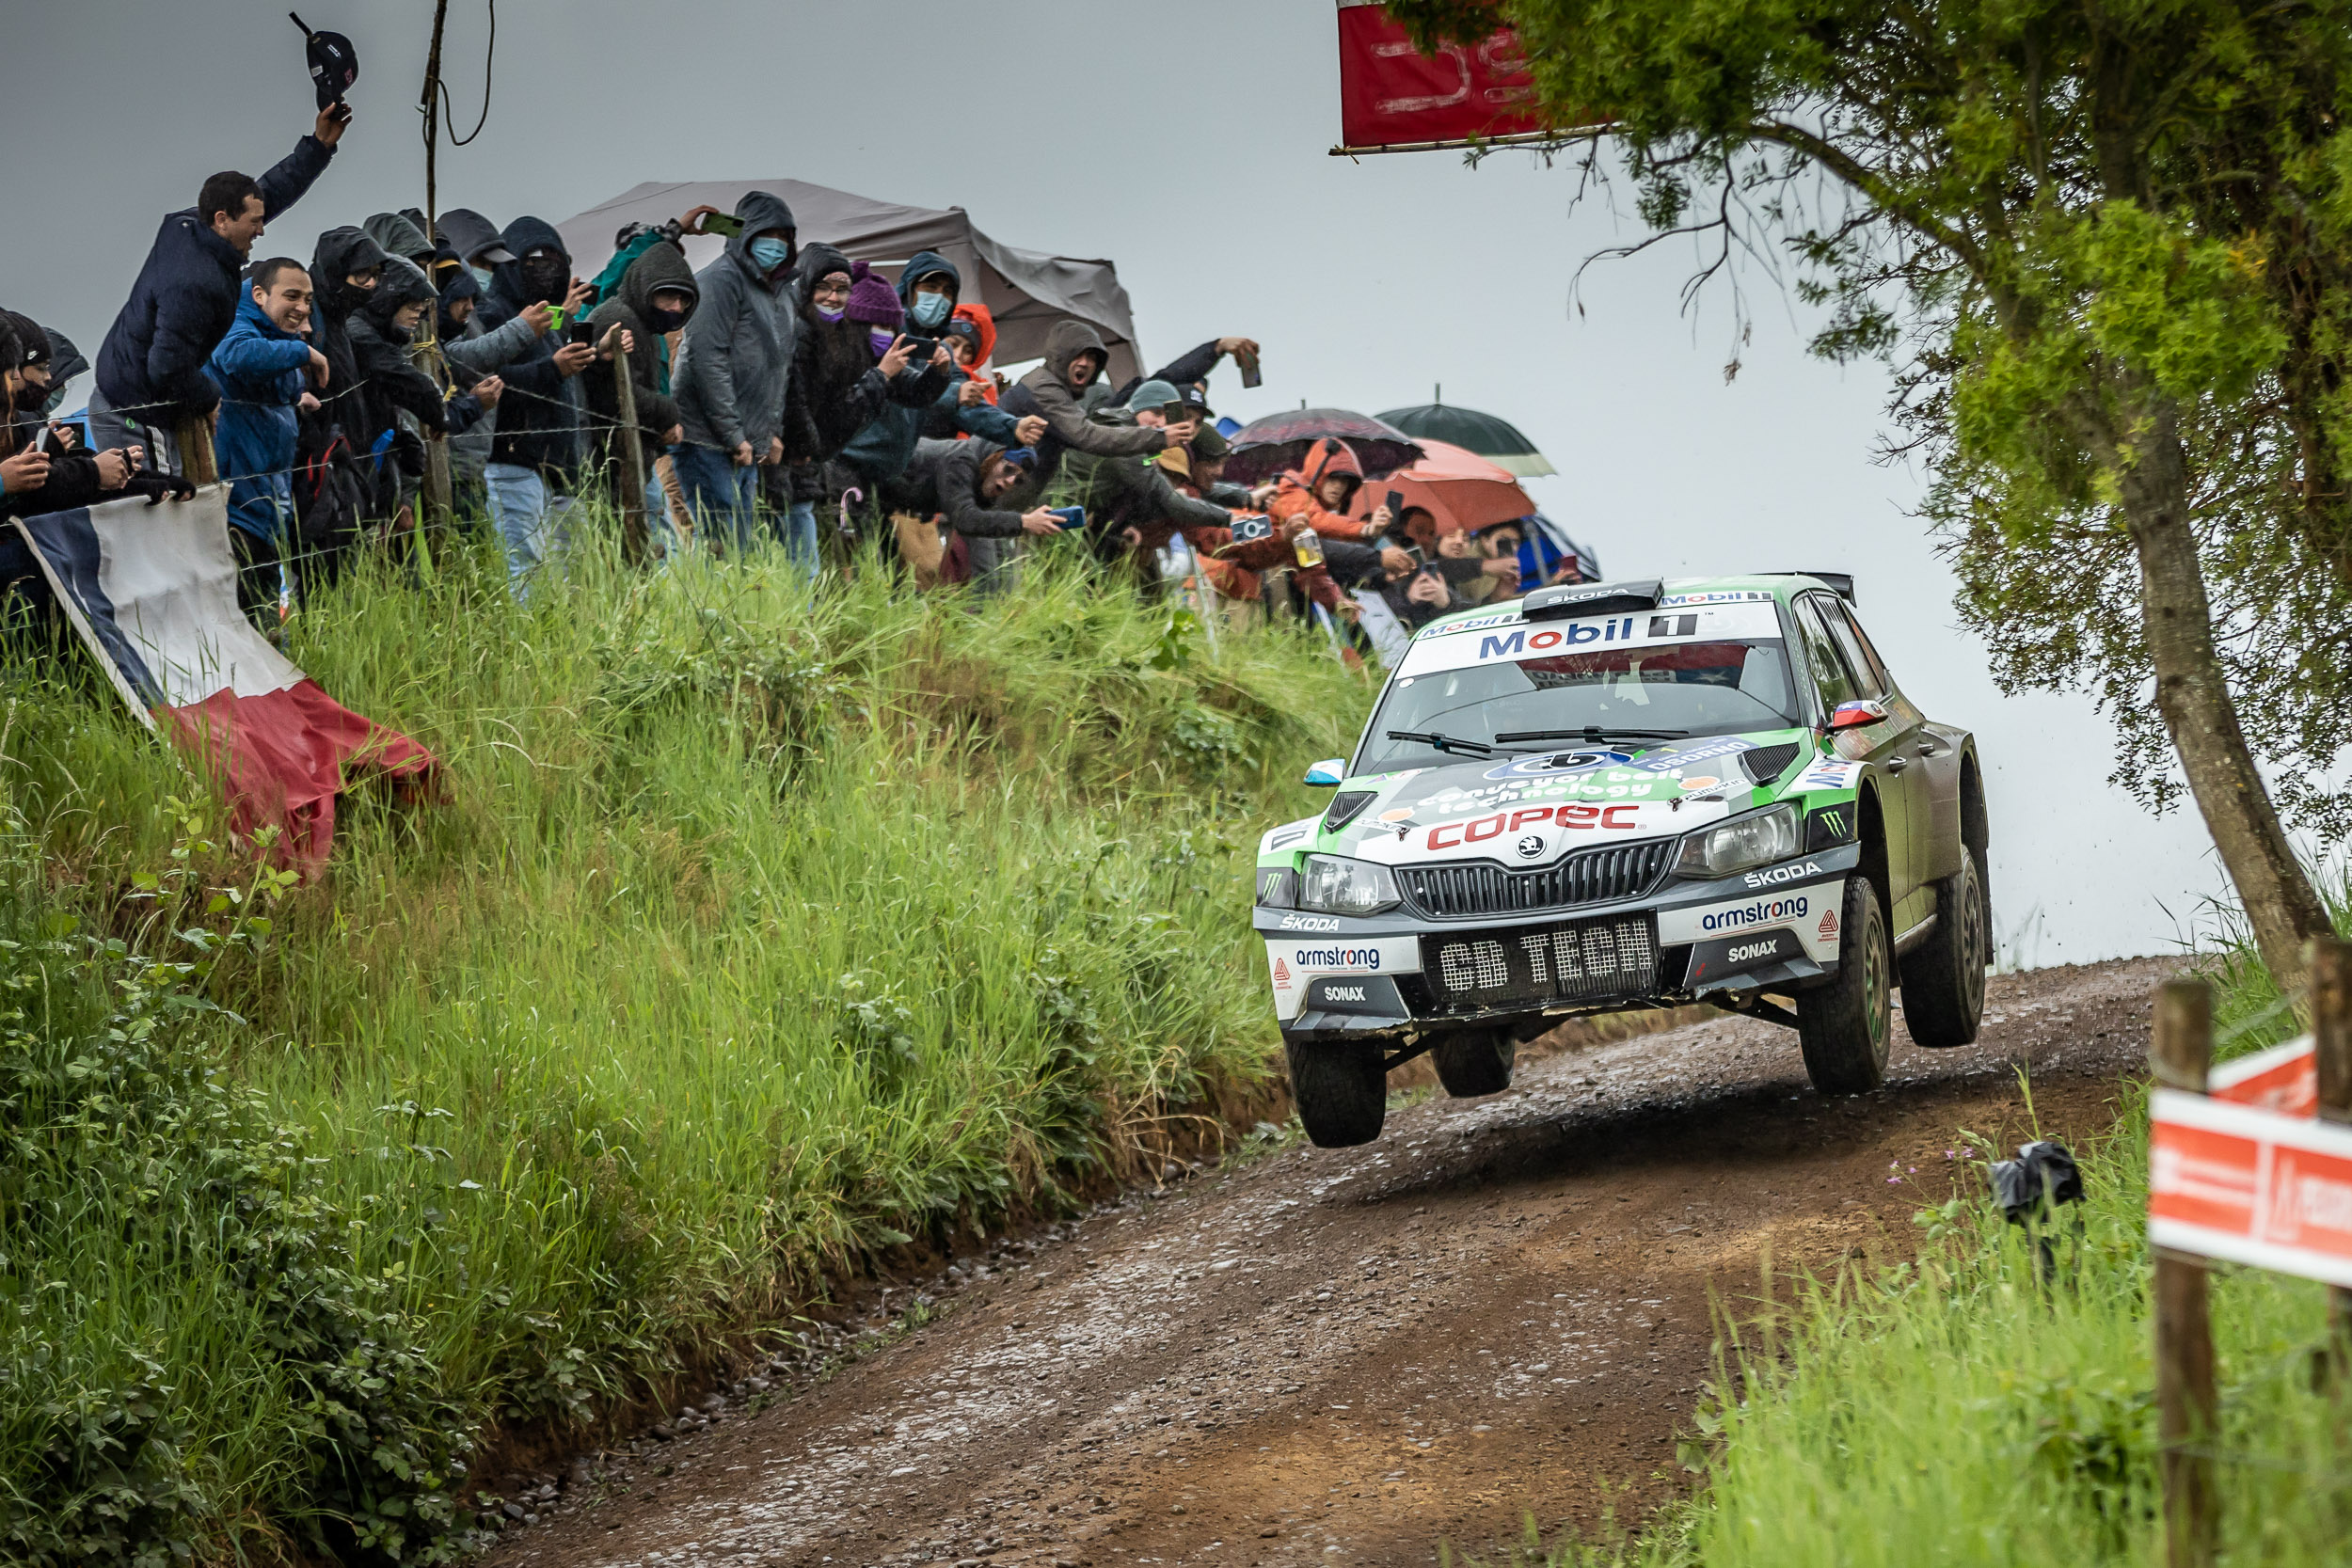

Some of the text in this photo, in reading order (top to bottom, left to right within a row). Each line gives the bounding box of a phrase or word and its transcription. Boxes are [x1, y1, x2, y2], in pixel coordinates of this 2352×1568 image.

[1547, 587, 1629, 606] ŠKODA
[1661, 593, 1741, 606] Mobil
[1422, 616, 1497, 638] Mobil
[1479, 617, 1633, 659] Mobil
[1646, 741, 1751, 771] OSORNO
[1417, 771, 1596, 807] conveyor
[1606, 768, 1684, 783] belt
[1438, 784, 1653, 815] technology
[1426, 804, 1640, 851] COPEC
[1743, 861, 1823, 889] ŠKODA
[1279, 913, 1342, 931] ŠKODA
[1702, 895, 1808, 930] armstrong
[1296, 946, 1380, 970] armstrong
[1519, 918, 1652, 984] TECH
[1728, 939, 1777, 963] SONAX
[1324, 987, 1366, 1002] SONAX
